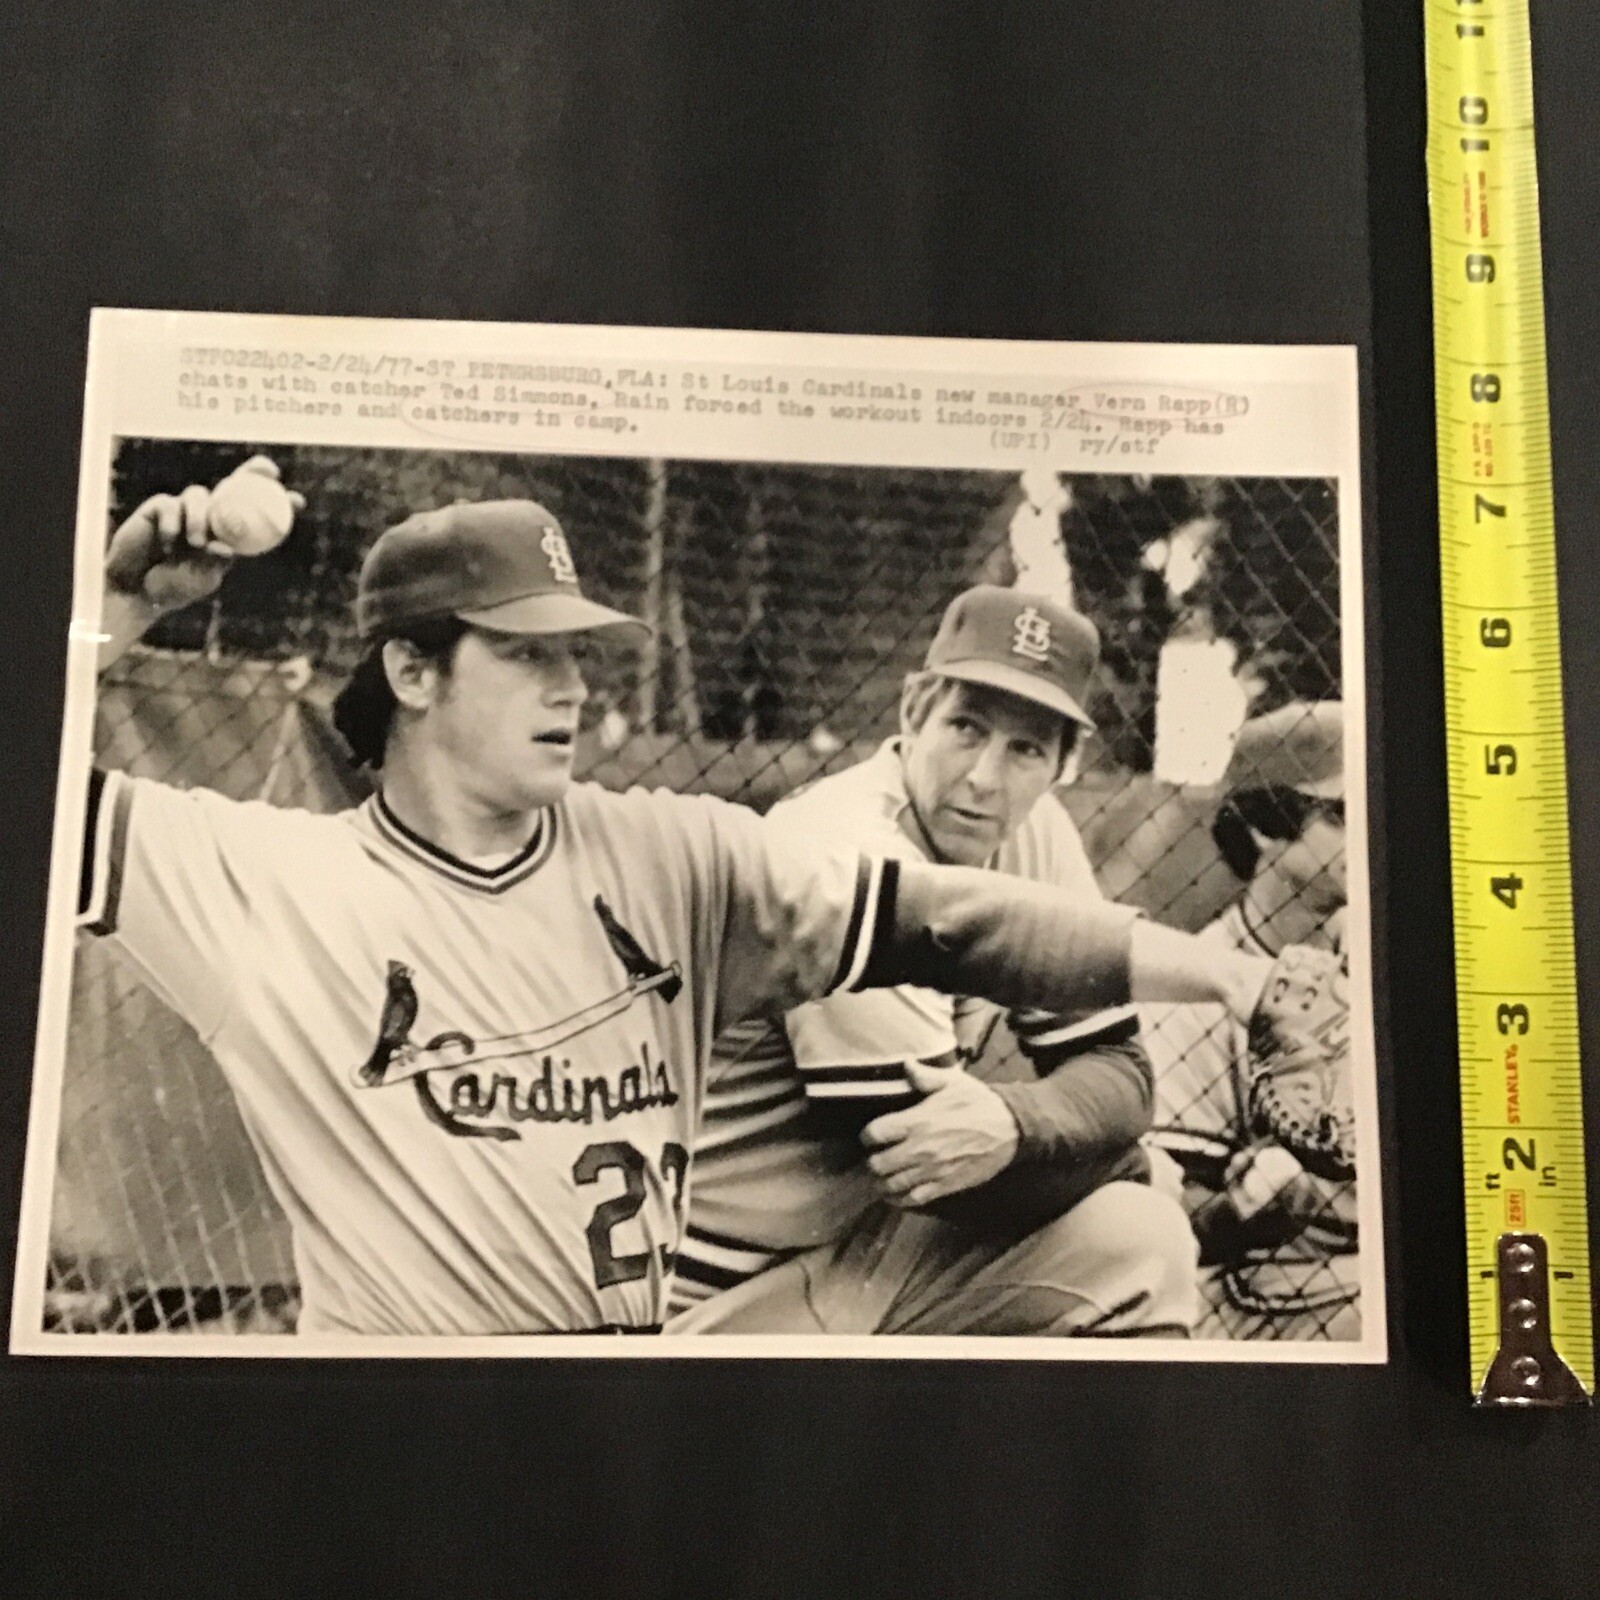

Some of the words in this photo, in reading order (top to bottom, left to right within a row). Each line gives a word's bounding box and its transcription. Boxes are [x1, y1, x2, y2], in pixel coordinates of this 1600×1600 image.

[1460, 96, 1489, 152] 10
[1466, 254, 1495, 283] 9
[178, 370, 248, 390] chats
[262, 374, 317, 393] with
[331, 379, 426, 399] catcher
[440, 383, 479, 401] Ted
[615, 391, 670, 411] Rain
[684, 394, 762, 415] forced
[777, 400, 815, 418] the
[830, 404, 921, 423] workout
[937, 408, 1027, 428] indoors
[1119, 416, 1172, 436] Rapp
[1183, 418, 1225, 434] has
[682, 371, 709, 390] St
[722, 373, 789, 394] Louis
[803, 378, 922, 402] Cardinals
[936, 388, 976, 403] new
[1094, 392, 1146, 411] Vern
[1471, 373, 1501, 403] 8
[178, 390, 219, 410] his
[234, 394, 342, 416] pitchers
[358, 400, 397, 418] and
[412, 405, 520, 426] catchers
[535, 408, 561, 427] in
[574, 414, 637, 434] camp.
[991, 431, 1051, 450] (UPI)
[1475, 494, 1507, 524] 7
[1481, 617, 1512, 648] 6
[1485, 744, 1517, 776] 5
[1490, 873, 1523, 909] 4
[1497, 1003, 1530, 1036] 3
[413, 1031, 679, 1141] Cardinals
[1502, 1137, 1537, 1171] 2
[1485, 1172, 1502, 1190] ft
[1538, 1166, 1558, 1187] in
[1508, 1193, 1522, 1223] 25ft
[1553, 1271, 1575, 1282] 1
